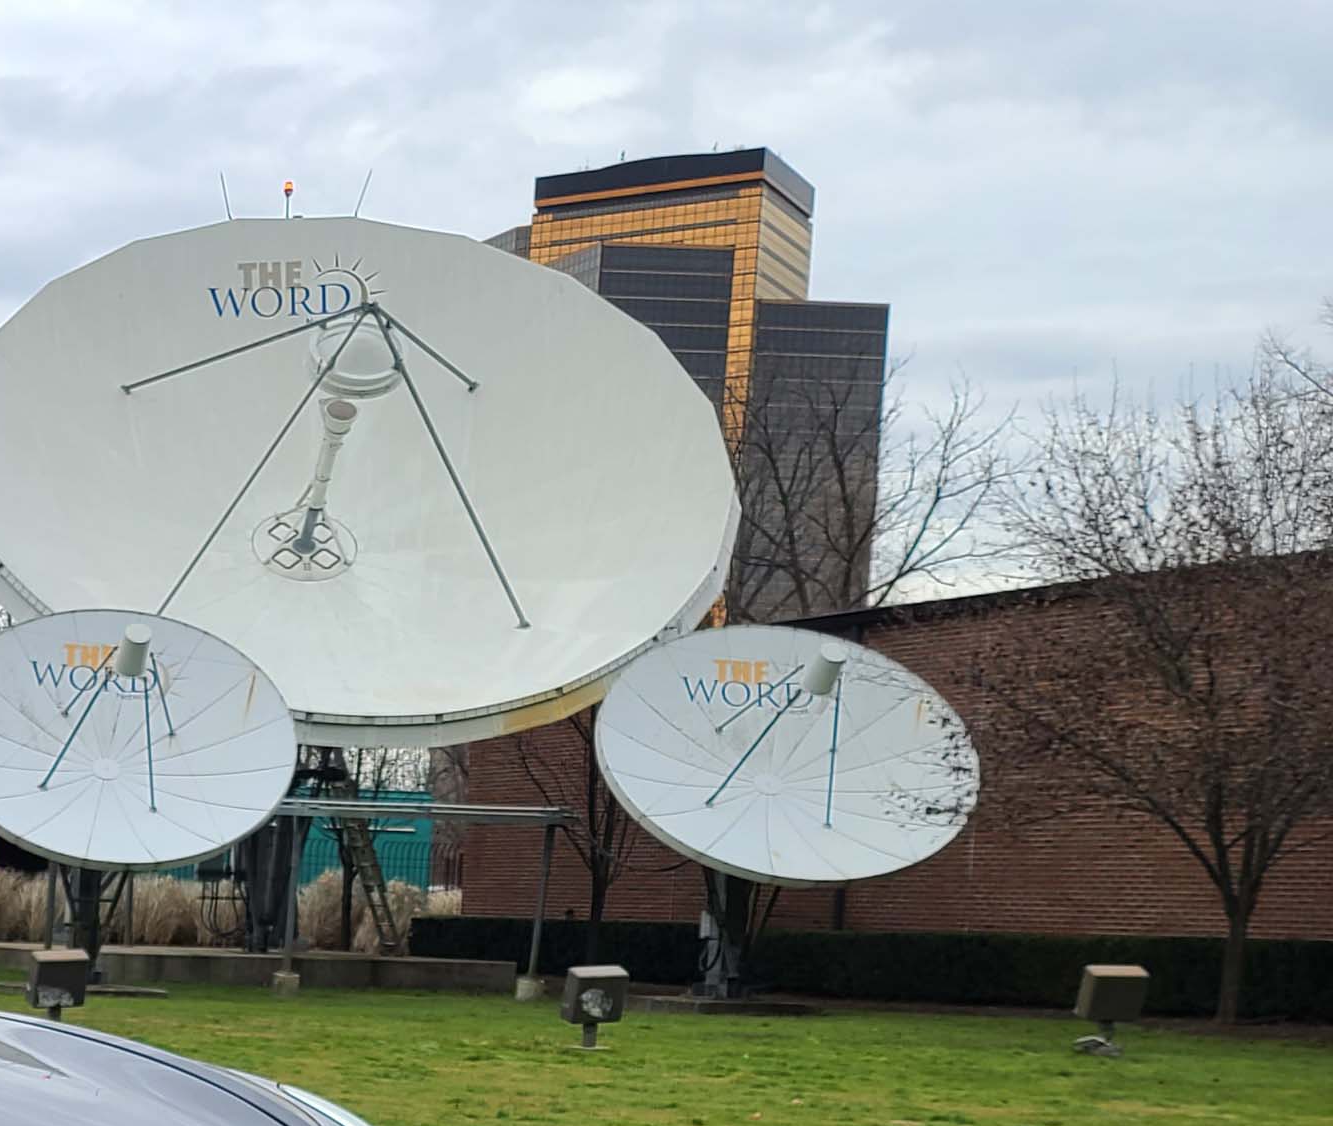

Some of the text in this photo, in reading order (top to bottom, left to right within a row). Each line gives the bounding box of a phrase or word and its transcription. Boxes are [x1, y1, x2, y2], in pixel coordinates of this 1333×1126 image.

[237, 261, 302, 291] THE
[208, 283, 351, 318] WORD
[714, 659, 769, 684] THE
[682, 676, 814, 708] WORD
